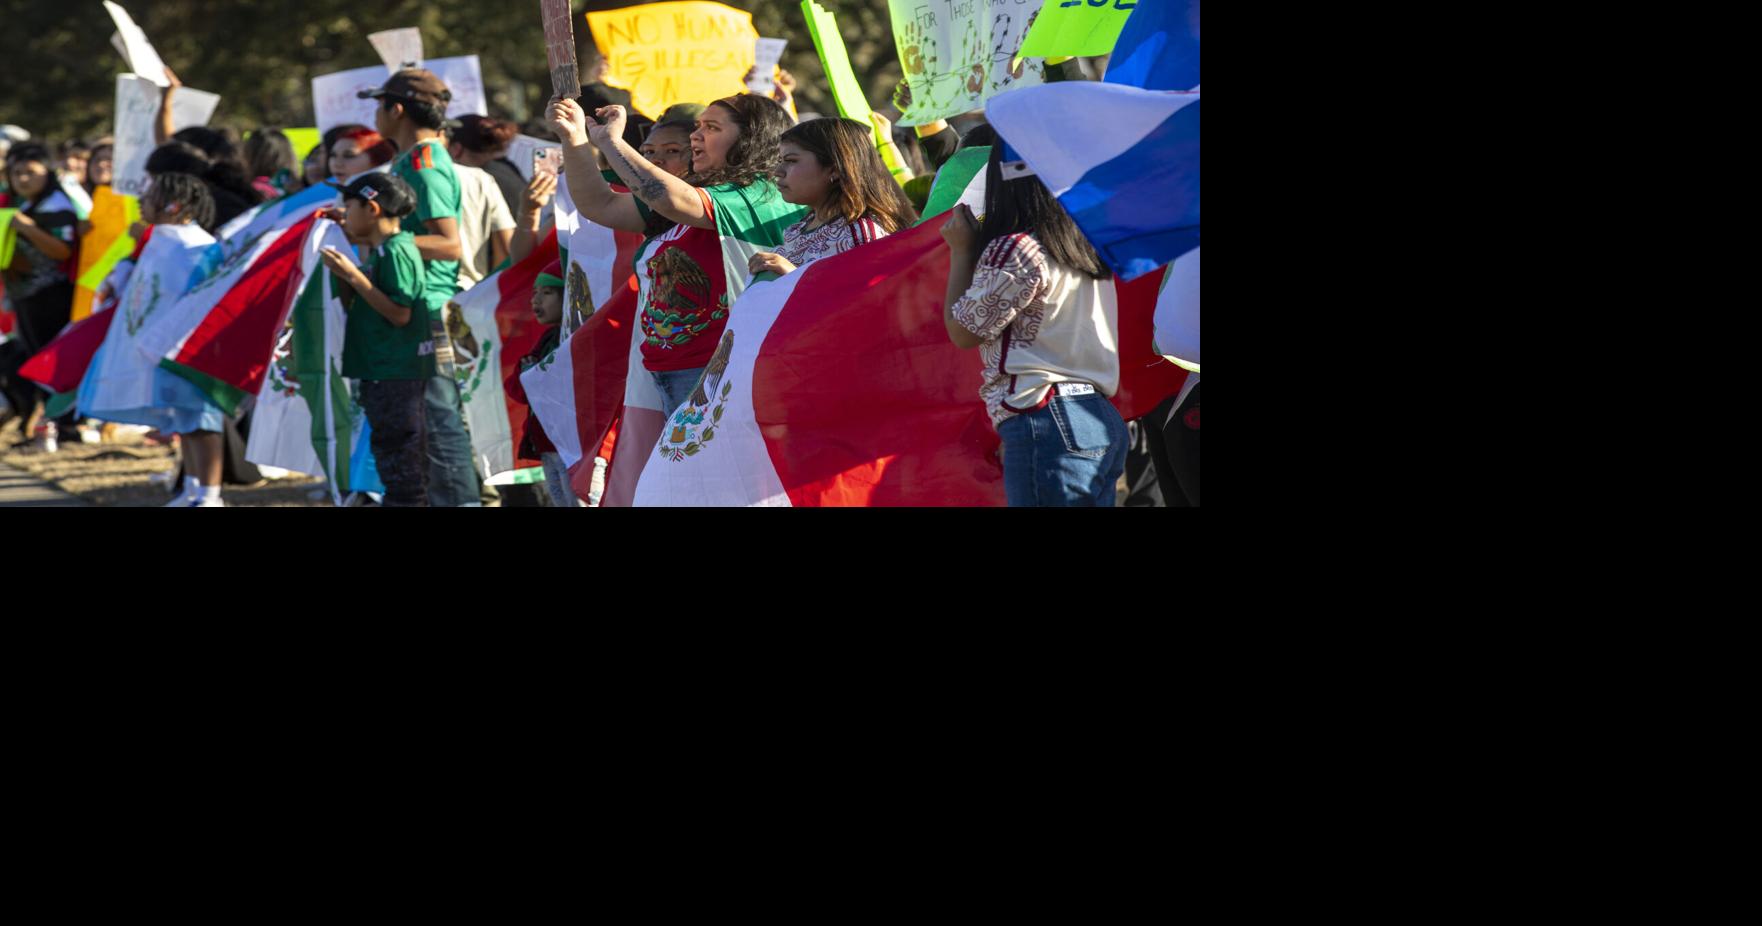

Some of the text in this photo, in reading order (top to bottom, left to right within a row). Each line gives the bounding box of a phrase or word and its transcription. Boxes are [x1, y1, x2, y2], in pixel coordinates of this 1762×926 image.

[606, 13, 660, 45] NO
[914, 4, 938, 29] FOR
[615, 50, 647, 76] IS
